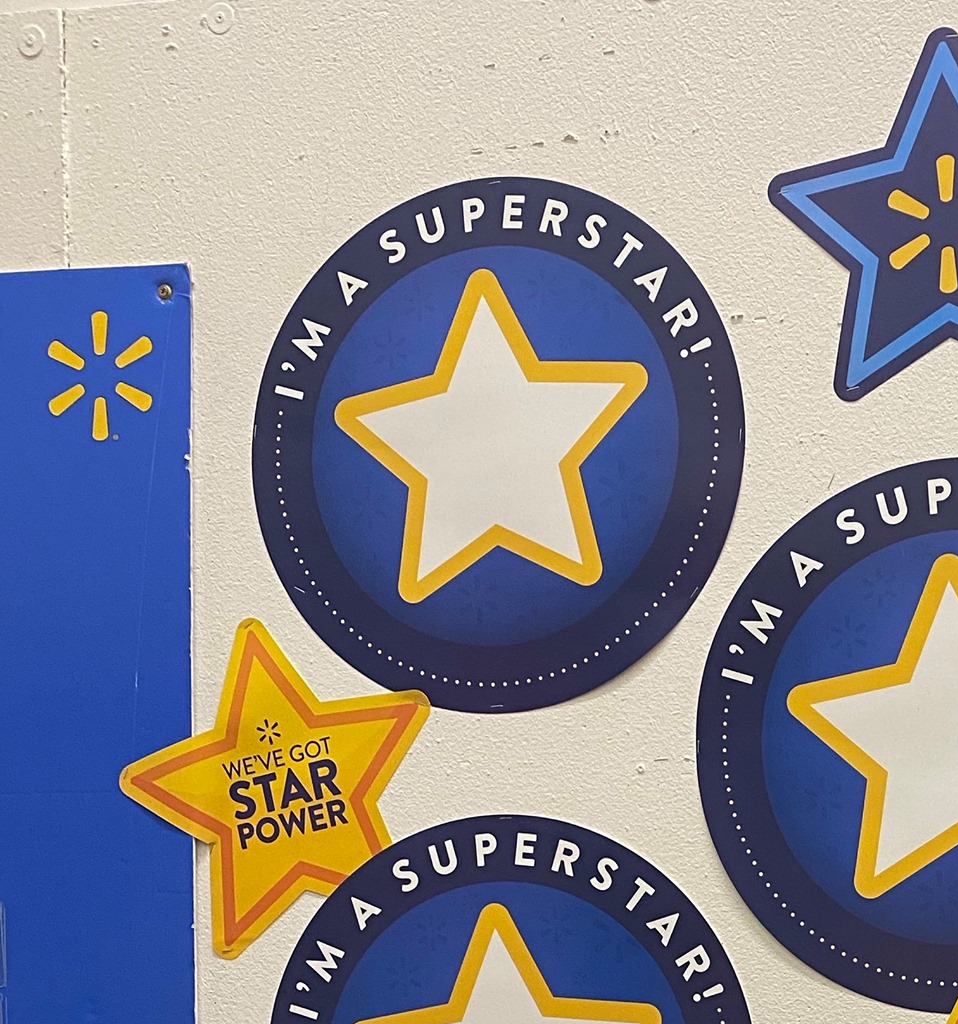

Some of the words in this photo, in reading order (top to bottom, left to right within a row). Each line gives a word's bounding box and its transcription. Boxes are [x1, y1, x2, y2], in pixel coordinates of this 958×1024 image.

[274, 318, 332, 401] I'M
[337, 271, 369, 306] A
[379, 194, 712, 359] SUPERSTAR!
[721, 599, 783, 685] I'M
[789, 550, 824, 588] A
[222, 748, 285, 779] WE'VE
[289, 736, 331, 762] GOT
[229, 758, 342, 820] STAR
[237, 799, 348, 850] POWER
[288, 940, 345, 1020] I'M
[350, 896, 382, 931] A
[392, 832, 724, 1003] SUPERSTAR!
